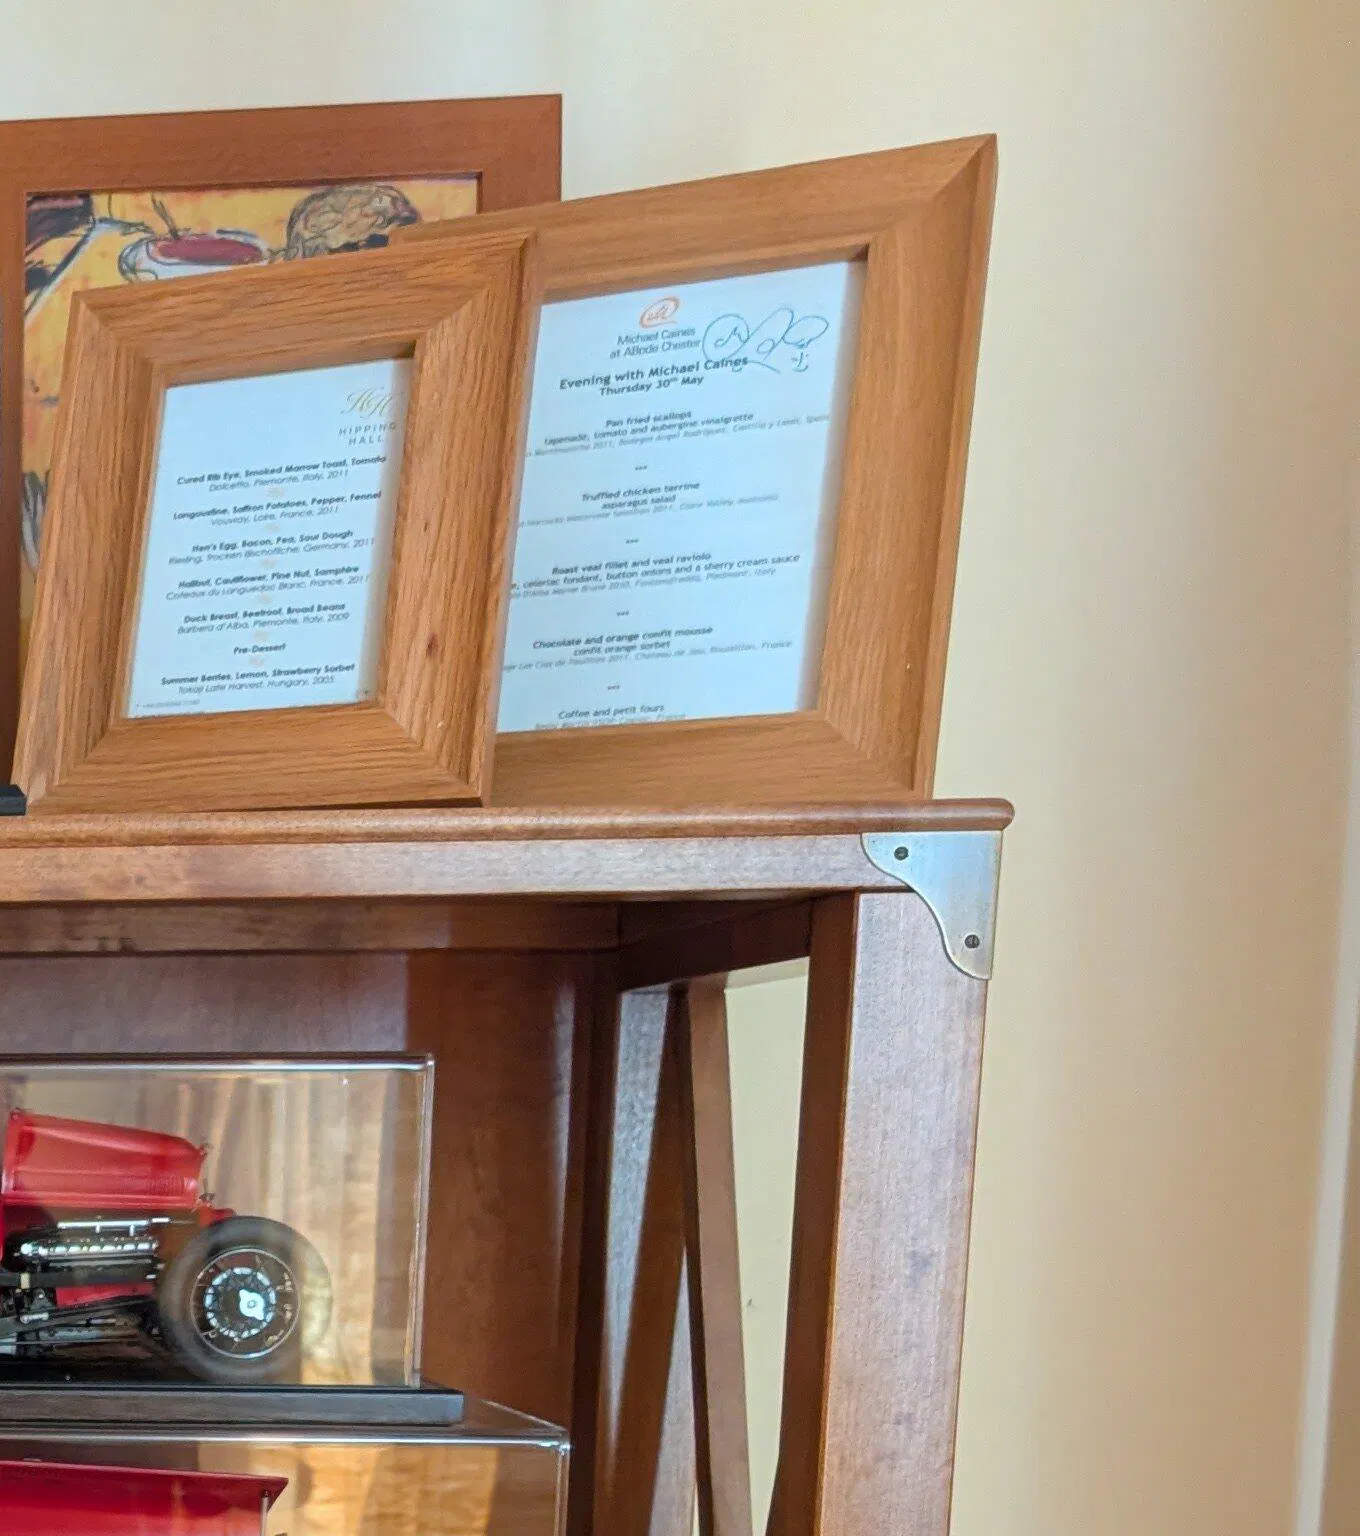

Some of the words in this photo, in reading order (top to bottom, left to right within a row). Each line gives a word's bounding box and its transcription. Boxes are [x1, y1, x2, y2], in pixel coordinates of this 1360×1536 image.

[617, 330, 657, 345] Michael
[660, 327, 696, 340] Caines
[560, 373, 612, 391] Evening
[615, 367, 644, 384] with
[648, 361, 700, 379] Michael
[704, 356, 748, 371] Caines
[599, 381, 651, 398] Thursday
[681, 375, 704, 389] May
[339, 422, 397, 436] HIPPING
[605, 416, 624, 428] Pan
[626, 413, 650, 426] fried
[349, 435, 384, 446] HALL
[622, 486, 661, 499] chicken
[664, 482, 700, 493] terrine
[631, 557, 650, 568] and
[652, 555, 673, 566] veal
[676, 552, 712, 564] raviolo
[533, 637, 582, 650] Chocolate
[585, 633, 603, 645] and
[605, 632, 639, 645] orange
[675, 625, 713, 637] mousse
